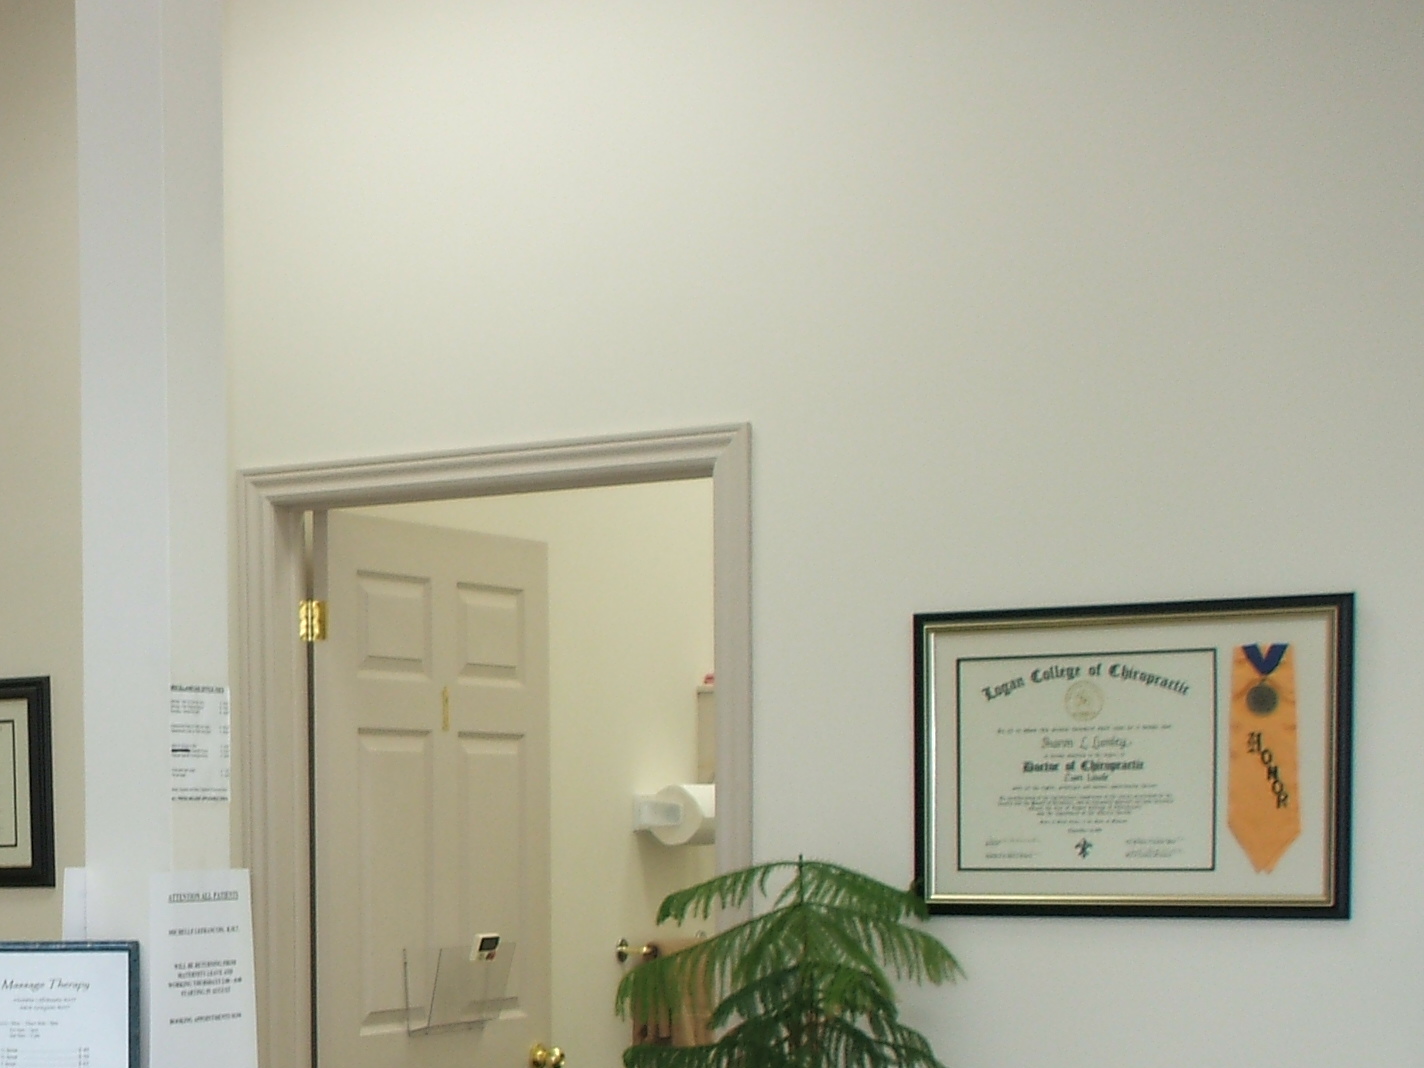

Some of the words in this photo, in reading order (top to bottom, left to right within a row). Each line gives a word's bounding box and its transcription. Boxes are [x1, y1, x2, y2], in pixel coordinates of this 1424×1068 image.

[981, 677, 1026, 702] Logan
[1030, 664, 1082, 684] College
[1088, 663, 1103, 677] of
[1108, 663, 1191, 697] Chiropractic
[1023, 760, 1060, 773] Doctor
[1247, 732, 1289, 809] HONOR
[1, 979, 45, 992] Massage
[49, 978, 90, 992] Therapy
